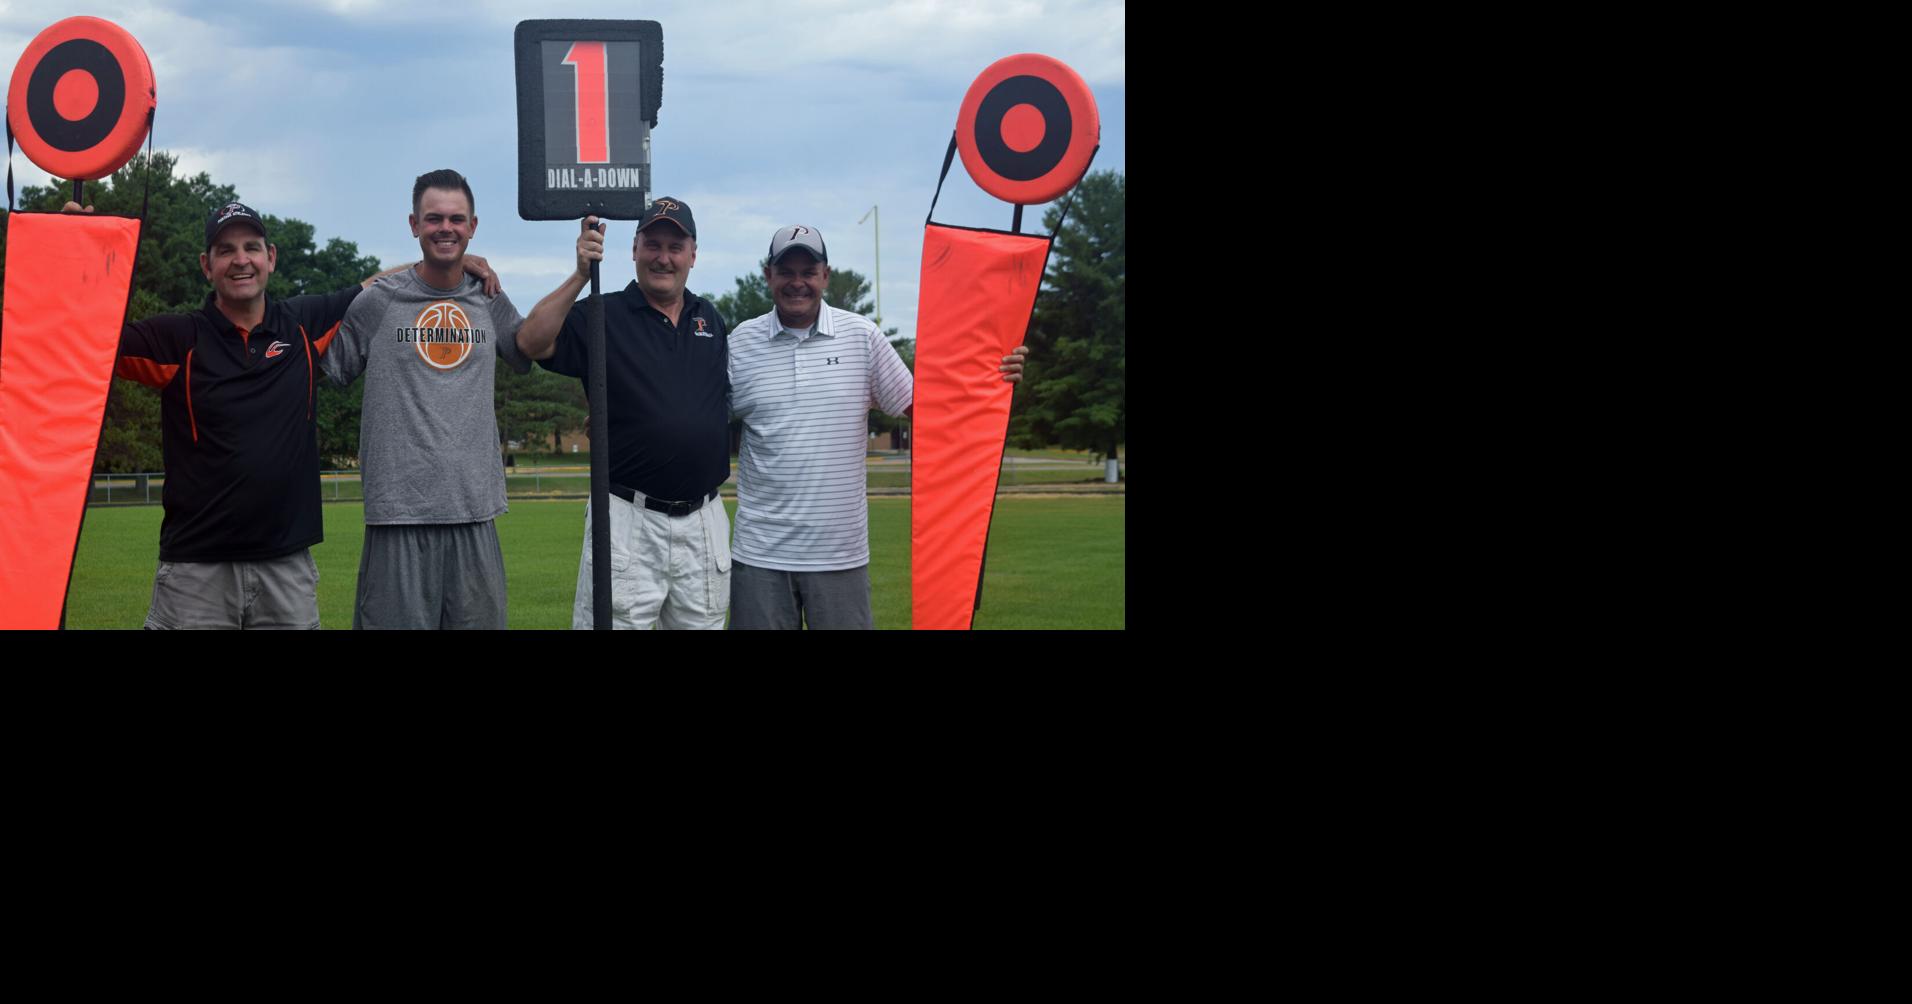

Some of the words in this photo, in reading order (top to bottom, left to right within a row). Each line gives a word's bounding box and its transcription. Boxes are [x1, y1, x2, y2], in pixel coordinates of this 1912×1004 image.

[561, 40, 610, 164] 1
[547, 167, 640, 189] DIAL-A-DOWN
[396, 327, 487, 344] DETERMINATION
